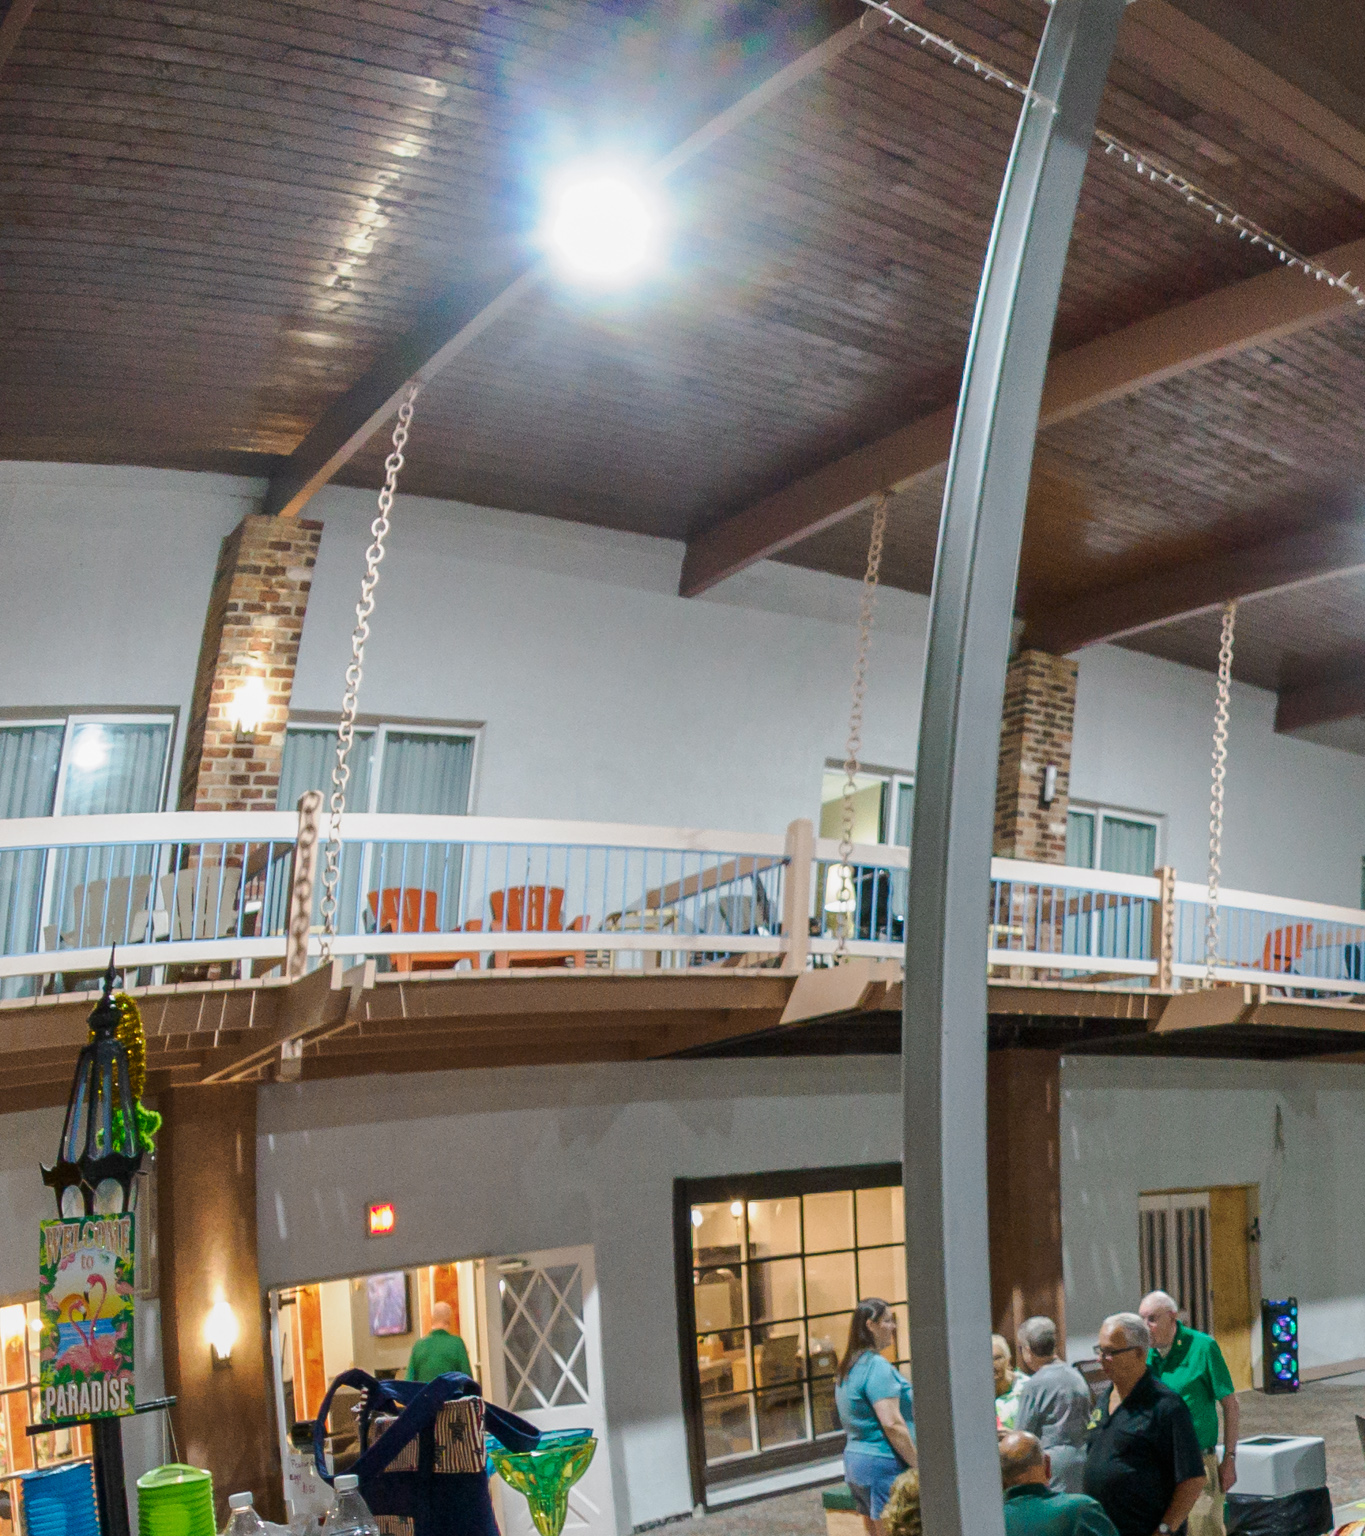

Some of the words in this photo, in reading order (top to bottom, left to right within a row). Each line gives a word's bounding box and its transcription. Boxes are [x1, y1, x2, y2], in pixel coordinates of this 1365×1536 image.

[44, 1220, 131, 1269] WELCOME
[80, 1254, 94, 1270] to
[45, 1377, 130, 1419] PARADISE
